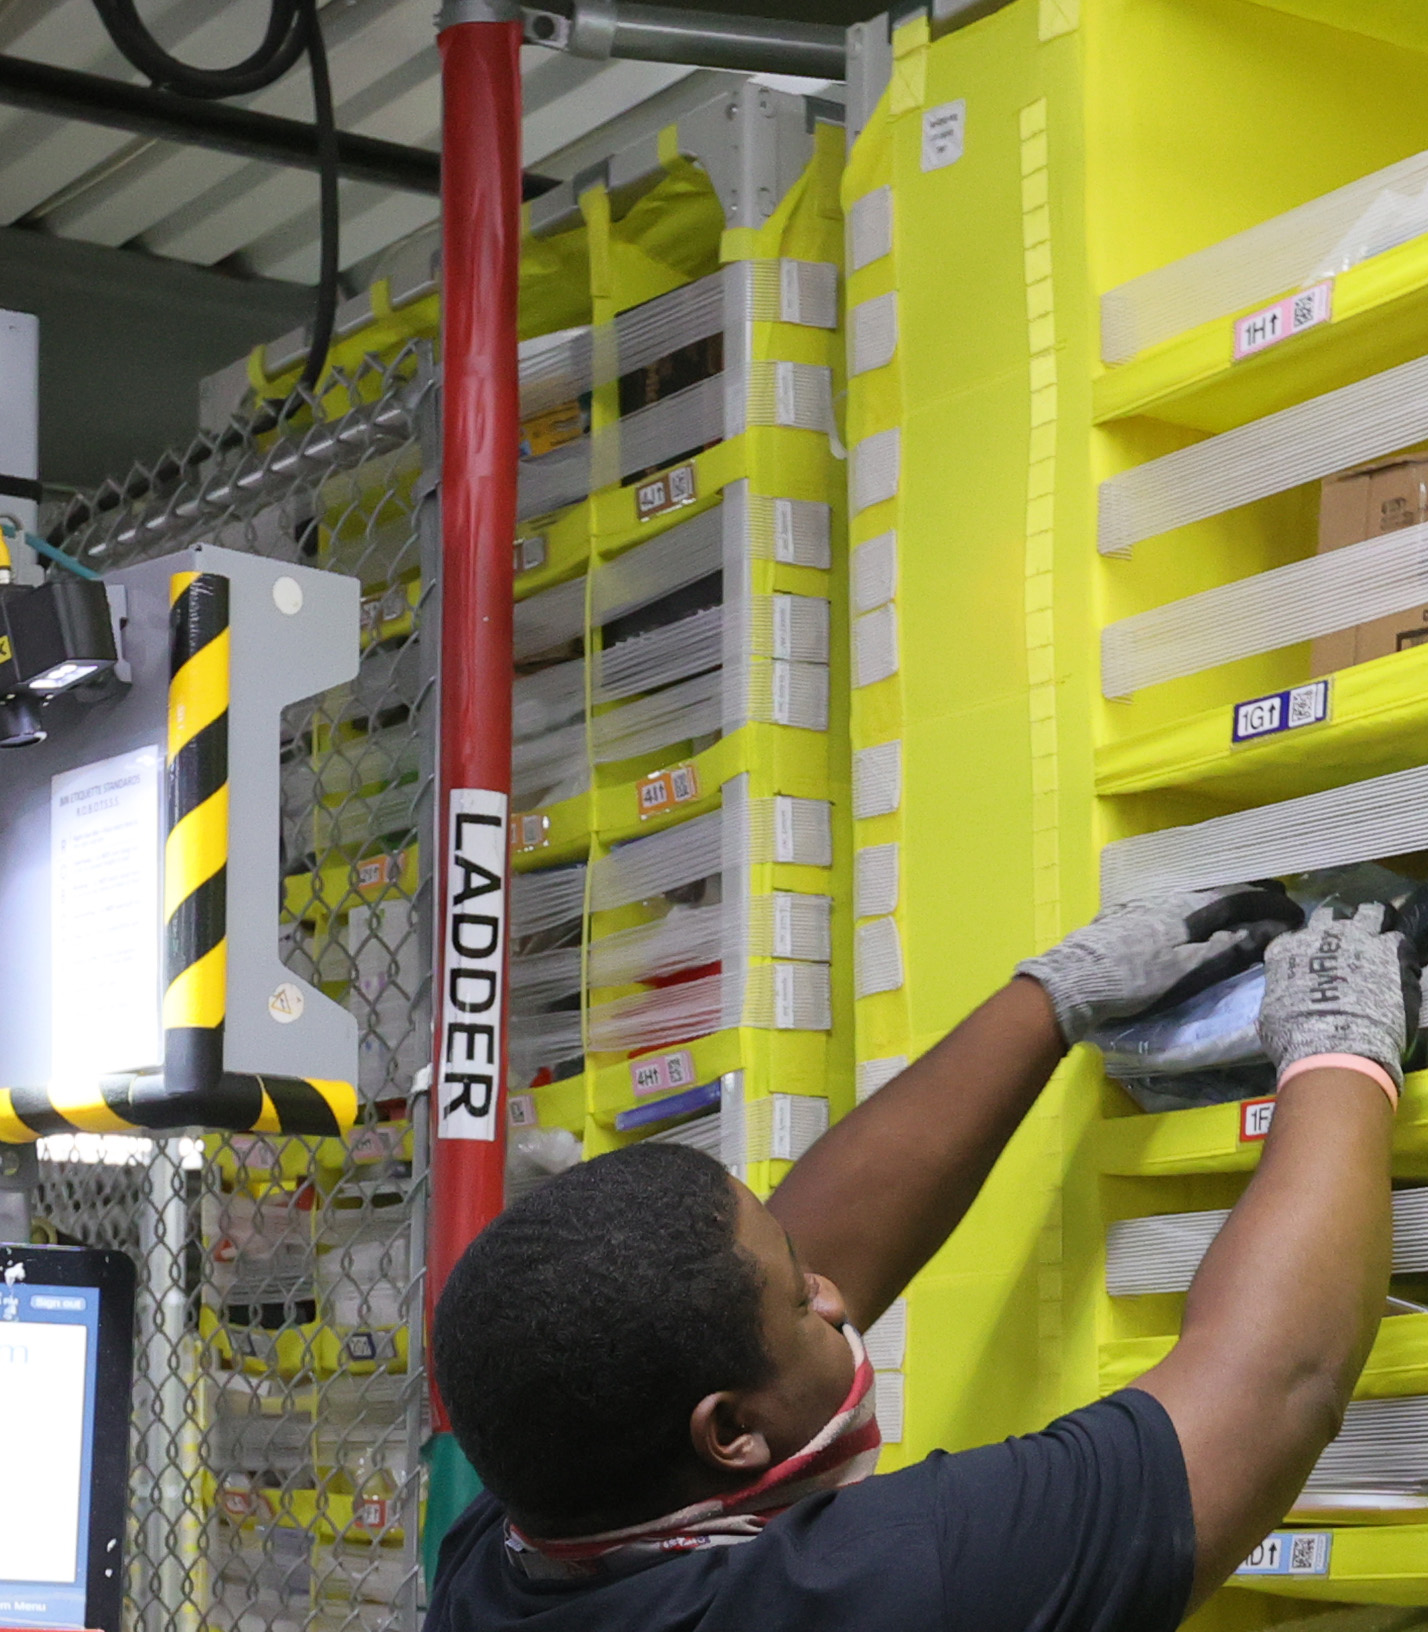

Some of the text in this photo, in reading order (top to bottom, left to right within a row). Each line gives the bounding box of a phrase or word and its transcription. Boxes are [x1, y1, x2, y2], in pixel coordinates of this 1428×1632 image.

[1244, 318, 1268, 347] 1H
[1242, 705, 1265, 732] 1G
[443, 812, 502, 1120] LADDER
[1309, 930, 1349, 1003] HyFlex
[1250, 1106, 1271, 1132] 1F
[35, 1297, 82, 1309] Sign out
[14, 1600, 47, 1612] Menu
